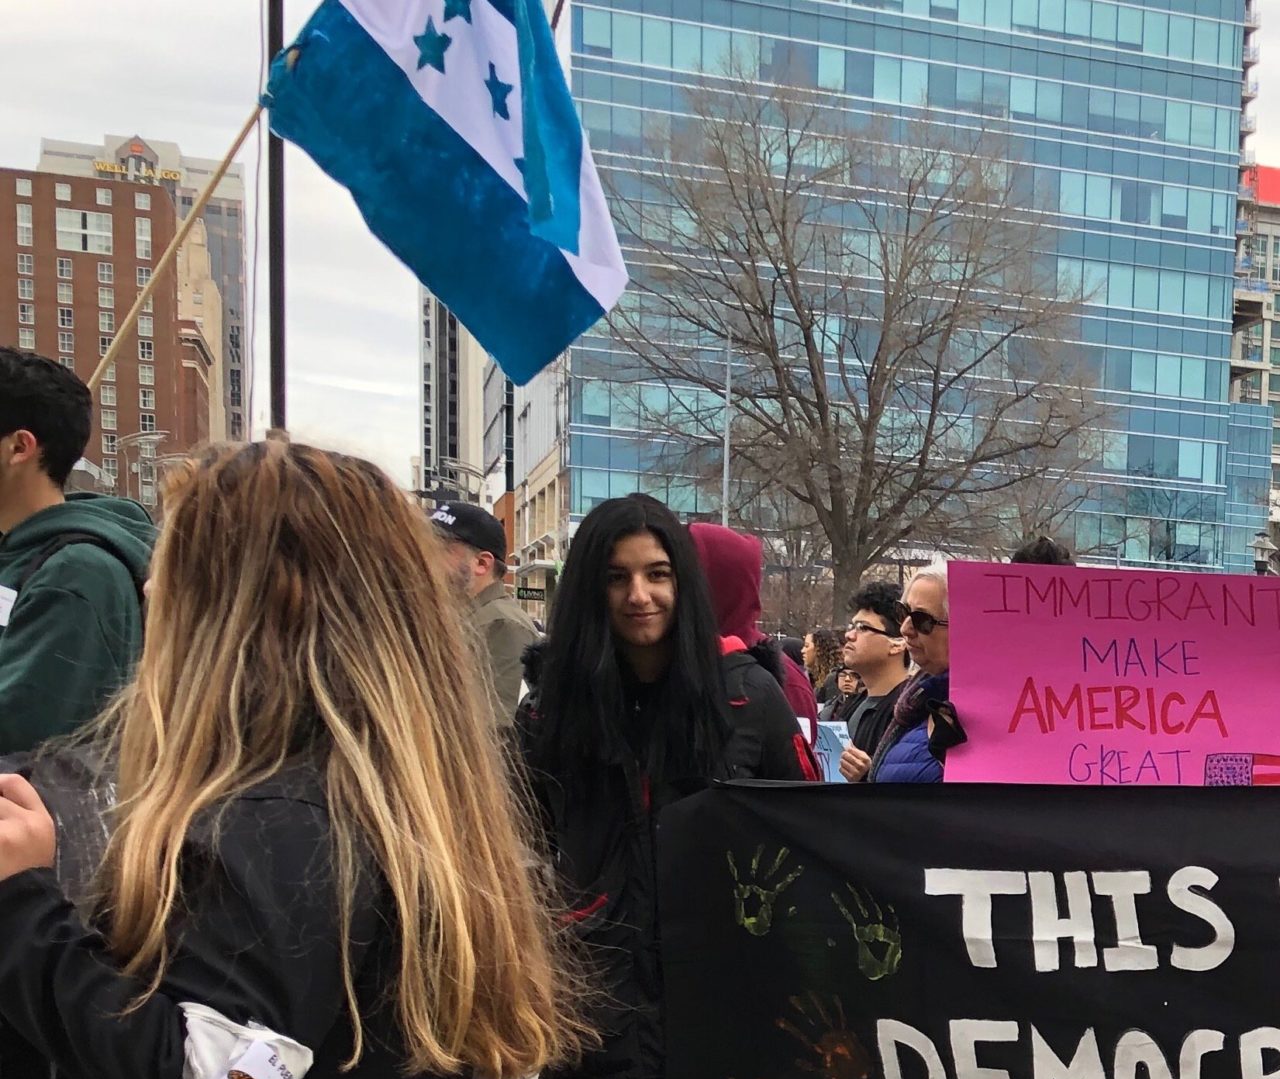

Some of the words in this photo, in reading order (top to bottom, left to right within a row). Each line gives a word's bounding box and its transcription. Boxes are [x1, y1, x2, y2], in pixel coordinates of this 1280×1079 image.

[94, 160, 129, 174] WELL
[1083, 637, 1201, 677] MAKE
[1007, 676, 1229, 738] AMERICA
[1069, 743, 1191, 785] GREAT
[923, 865, 1236, 973] THIS
